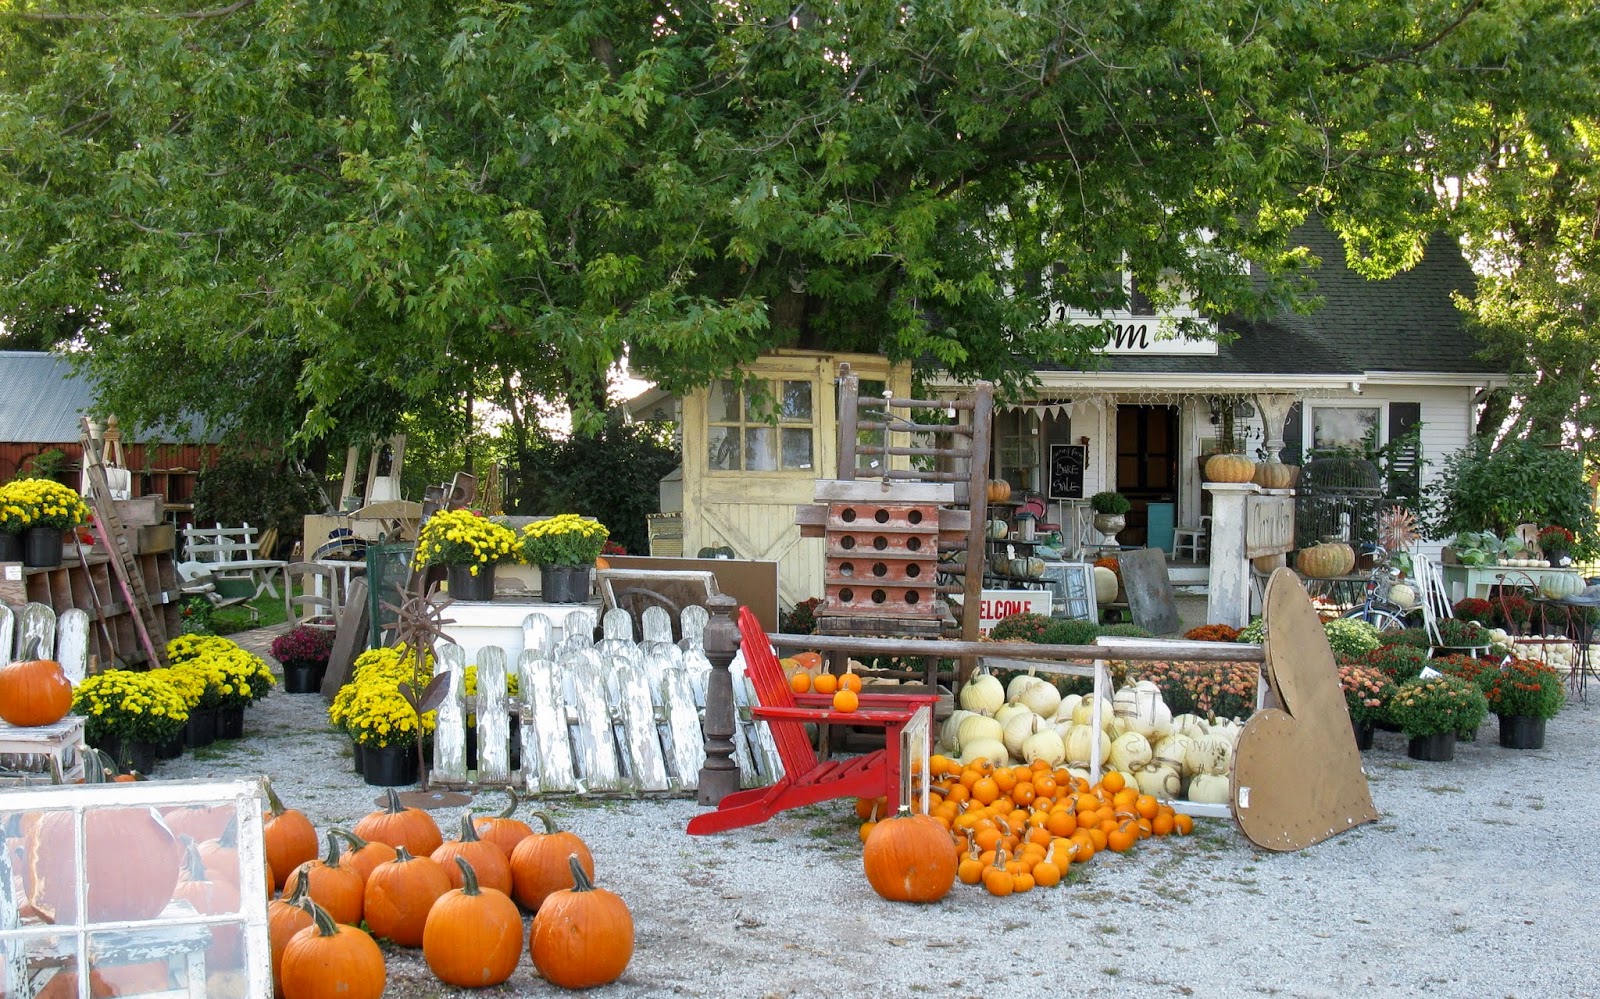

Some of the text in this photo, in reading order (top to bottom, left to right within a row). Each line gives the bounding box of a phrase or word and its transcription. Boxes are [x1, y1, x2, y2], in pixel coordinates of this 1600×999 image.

[1055, 462, 1079, 476] BAKE
[1052, 477, 1081, 493] SALE
[979, 600, 1032, 620] ELCOME
